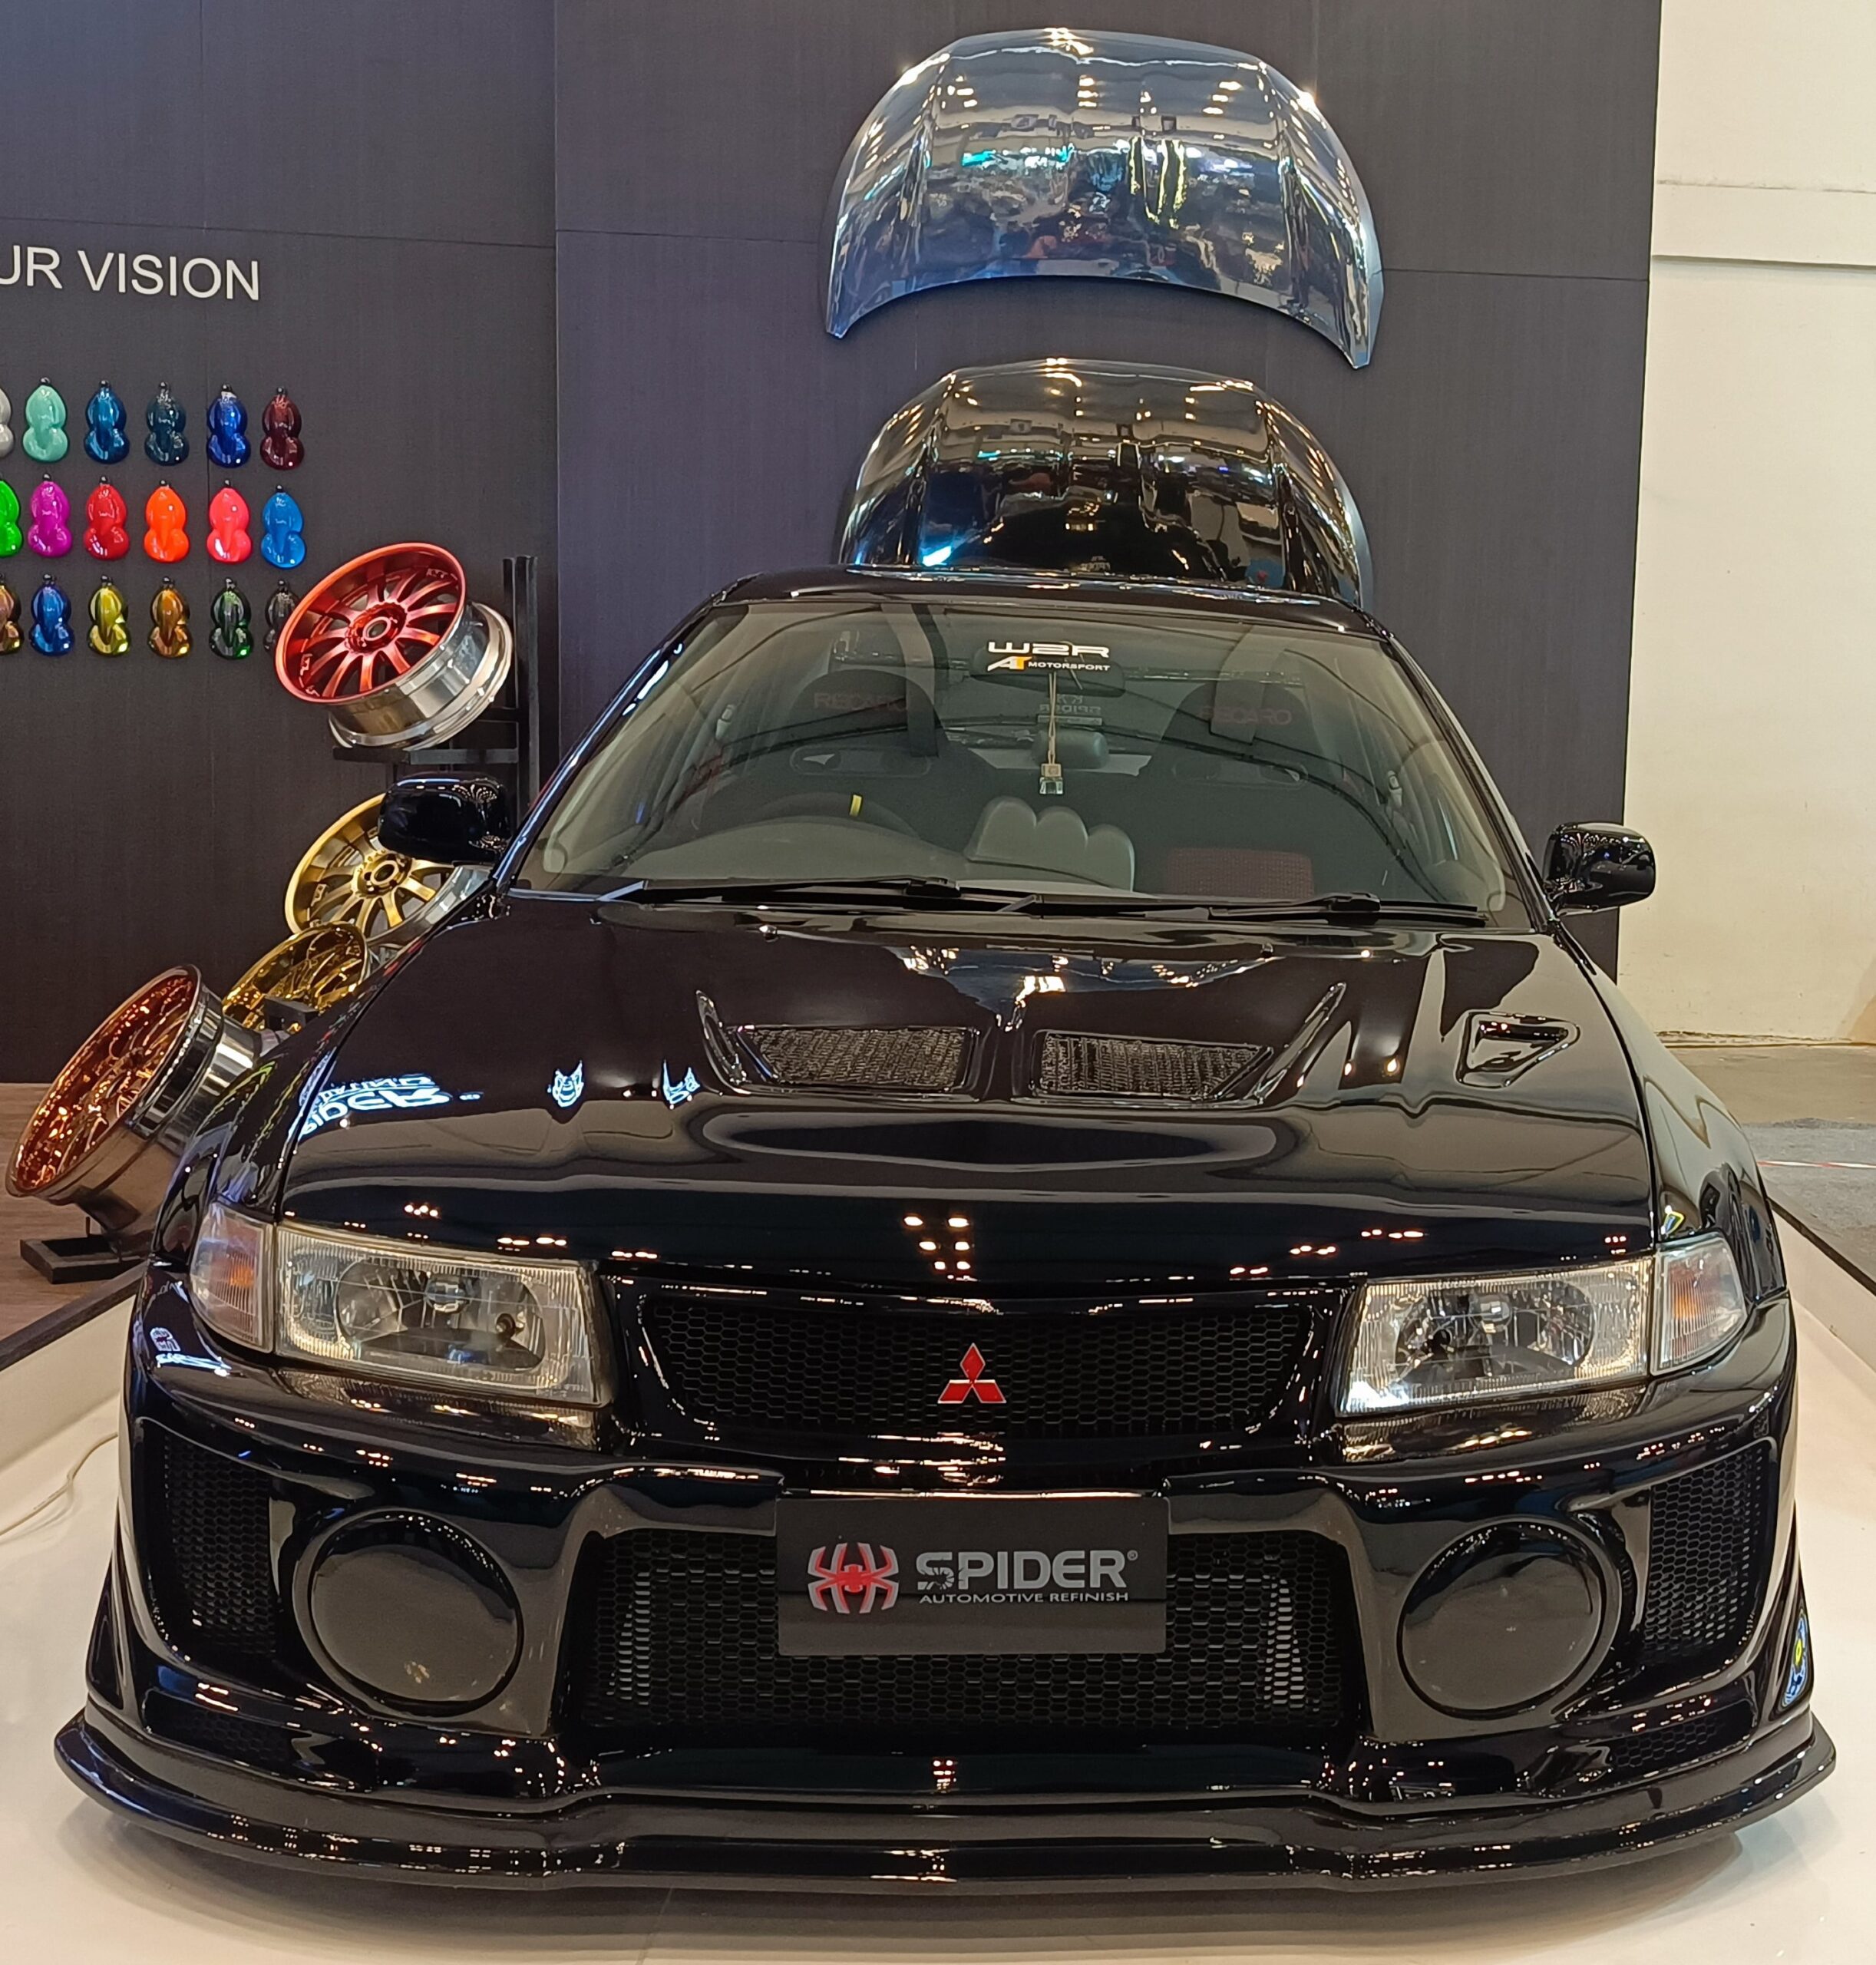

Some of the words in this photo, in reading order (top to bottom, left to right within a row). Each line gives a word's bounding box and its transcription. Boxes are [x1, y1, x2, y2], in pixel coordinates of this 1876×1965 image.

[78, 250, 259, 301] VISION
[1028, 661, 1111, 672] MOTORSPORT
[919, 1593, 1044, 1604] AUTOMOTIVE
[1049, 1591, 1129, 1603] REFINISH
